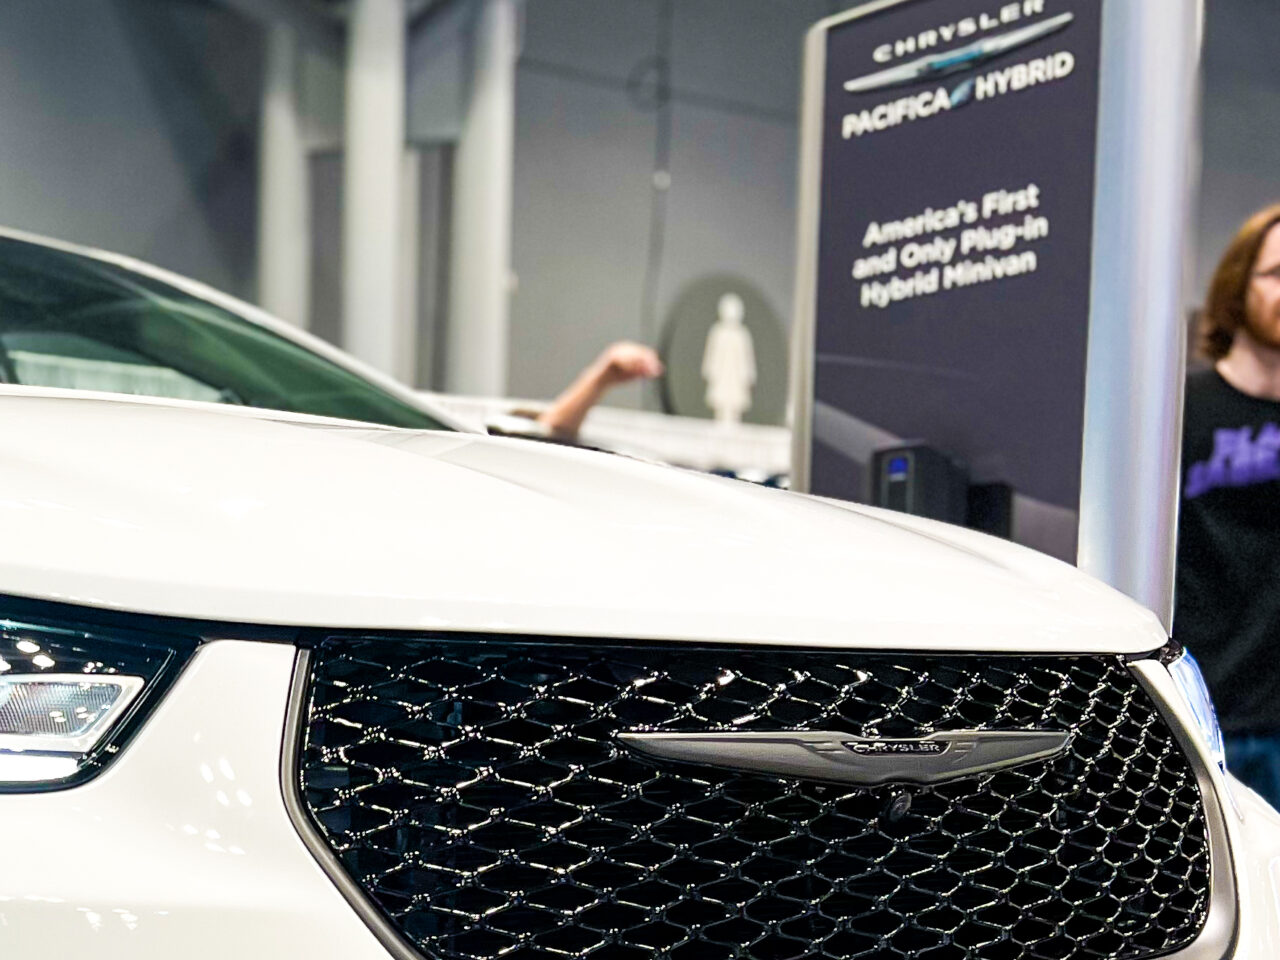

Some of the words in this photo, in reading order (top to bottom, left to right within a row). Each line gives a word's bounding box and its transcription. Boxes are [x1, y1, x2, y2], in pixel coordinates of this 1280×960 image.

[873, 0, 1045, 63] CHRYSLER
[842, 86, 951, 139] PACIFICA
[975, 51, 1075, 100] HYBRID
[852, 247, 898, 280] and
[899, 236, 957, 269] Only
[960, 214, 1049, 255] Plug-in
[862, 200, 978, 248] America's
[982, 183, 1040, 220] First
[860, 267, 939, 309] Hybrid
[942, 250, 1037, 290] Minivan
[853, 742, 940, 753] CHRYSLER
